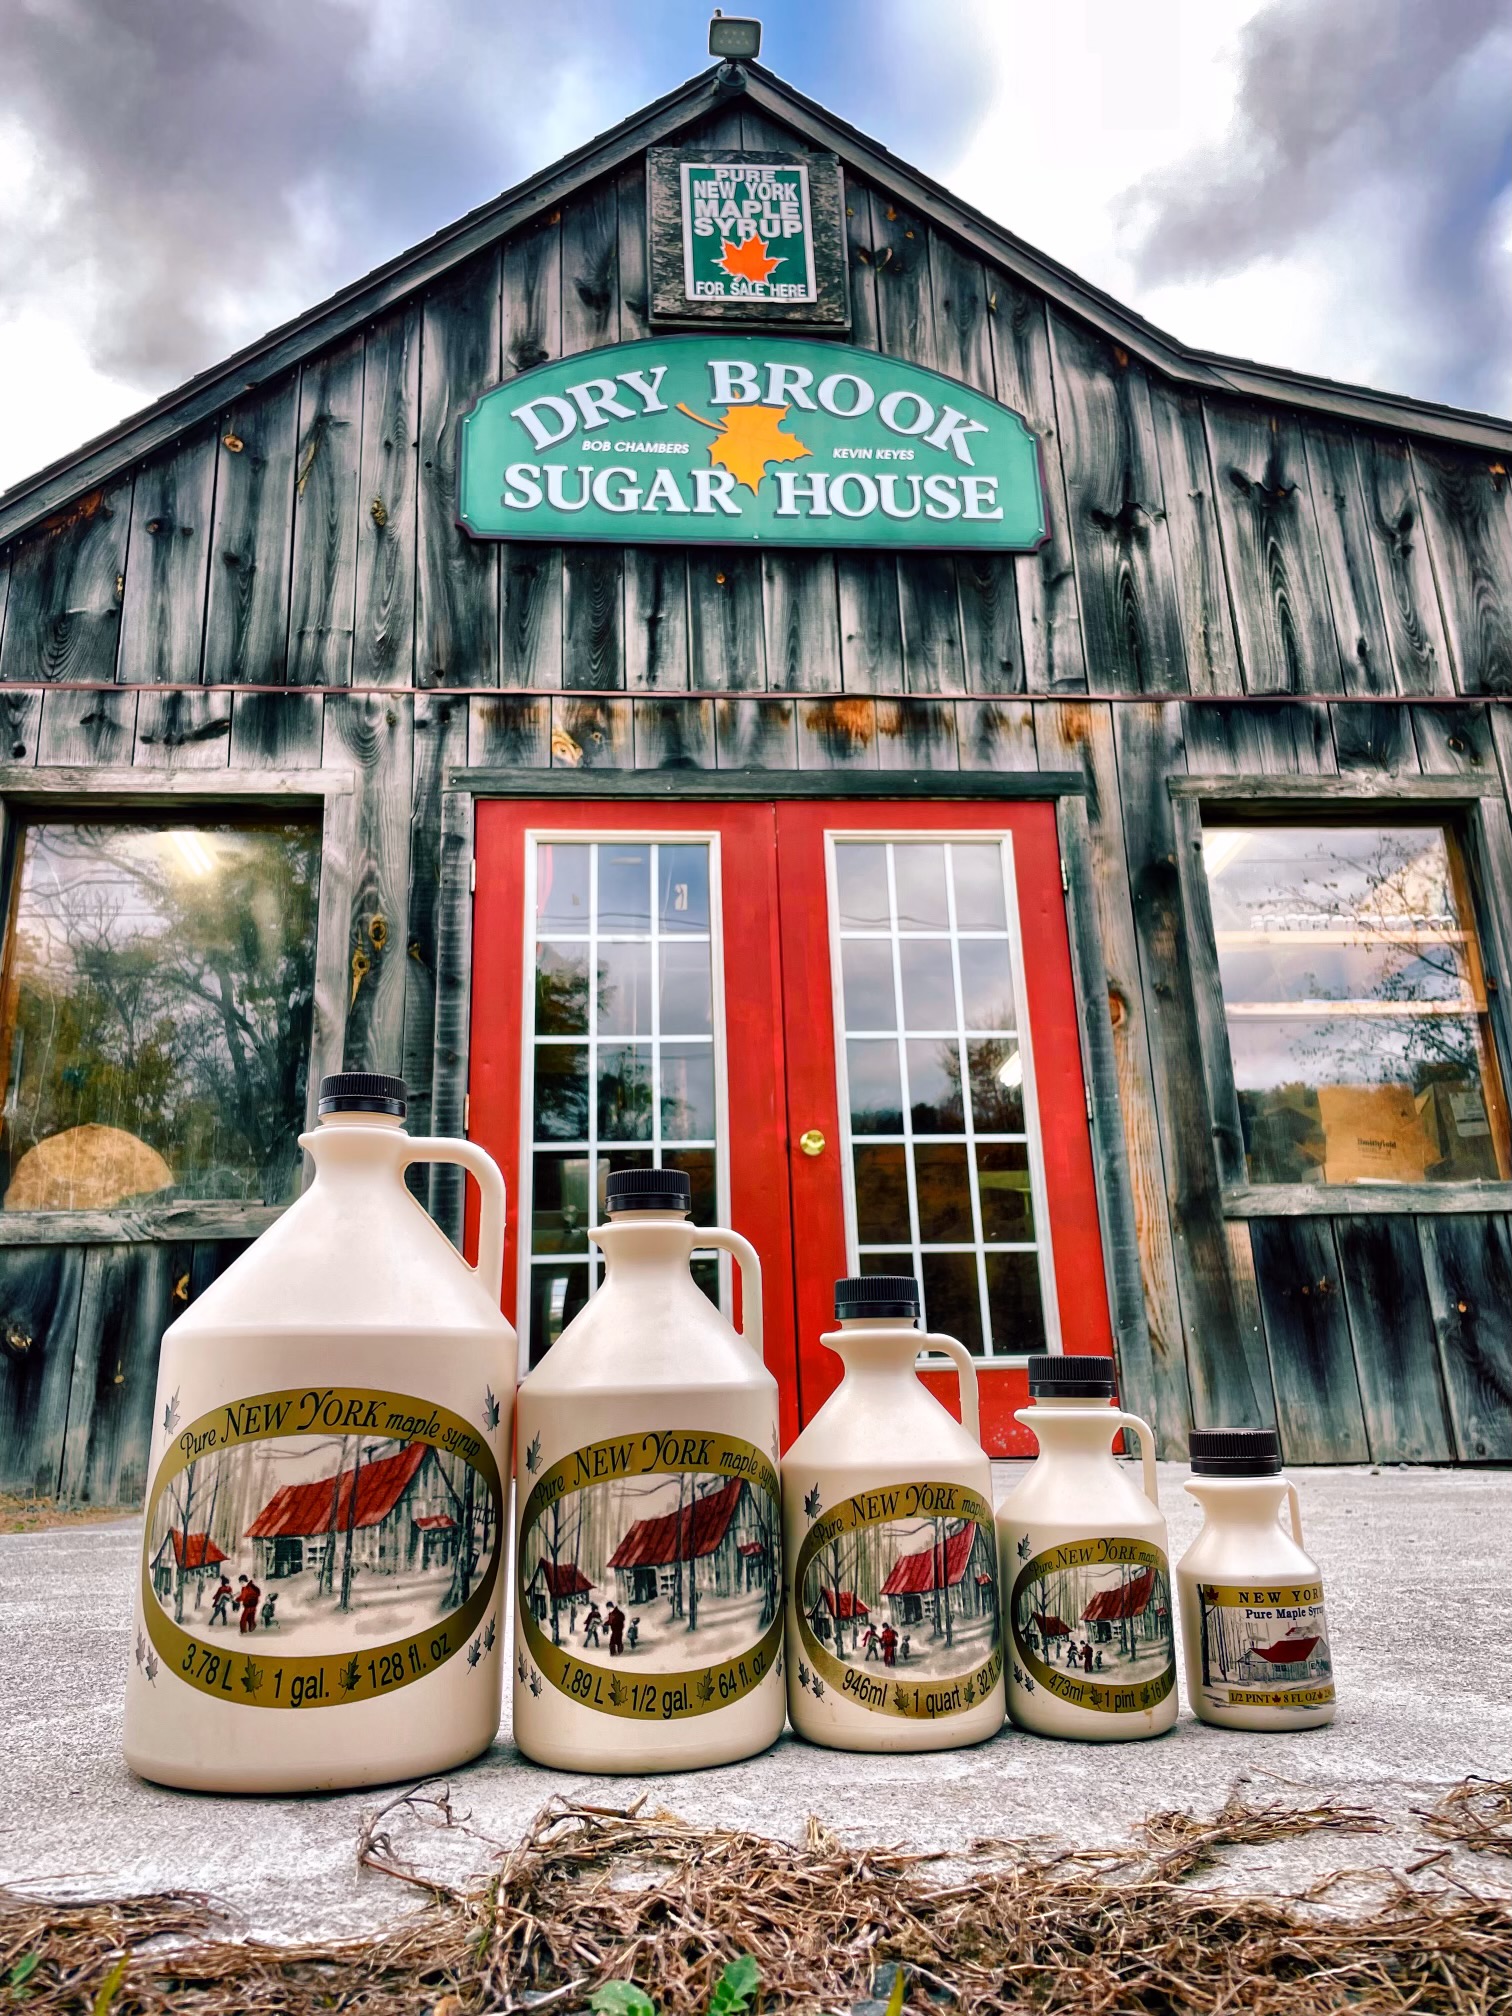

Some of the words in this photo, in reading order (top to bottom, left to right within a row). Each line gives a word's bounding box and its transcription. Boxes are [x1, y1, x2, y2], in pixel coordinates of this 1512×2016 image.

[693, 180, 736, 199] NEW
[745, 181, 799, 201] YORK
[714, 169, 776, 183] PURE
[694, 199, 800, 220] MAPLE
[694, 218, 803, 238] SYRUP
[696, 281, 724, 296] FOR
[730, 282, 765, 297] SALE
[769, 283, 806, 298] HERE
[511, 365, 670, 452] DRY
[707, 361, 989, 467] BROOK
[582, 440, 612, 452] BOB
[614, 441, 690, 454] CHAMBERS
[833, 448, 872, 460] KEVIN
[875, 448, 915, 461] KEYES
[503, 463, 742, 515] SUGAR
[775, 473, 1004, 520] HOUSE
[180, 1428, 216, 1459] Pure
[220, 1402, 292, 1443] NEW
[297, 1390, 386, 1431] YORK
[385, 1411, 441, 1440] maple
[442, 1427, 481, 1457] syrup
[534, 1476, 565, 1506] Pure
[573, 1442, 634, 1485] NEW
[642, 1431, 715, 1472] YORK
[720, 1448, 758, 1478] maple
[812, 1518, 844, 1545] Pure
[850, 1492, 901, 1528] NEW
[905, 1483, 959, 1517] YORK
[1029, 1560, 1053, 1577] Pure
[1056, 1546, 1094, 1569] NEW
[1097, 1537, 1138, 1562] YORK
[1238, 1591, 1281, 1604] NEW
[1245, 1609, 1272, 1619] Pure
[1275, 1607, 1306, 1621] Maple
[182, 1643, 222, 1686] 3.78
[222, 1658, 232, 1692] L
[274, 1669, 281, 1699] 1
[290, 1670, 330, 1708] gal.
[367, 1651, 405, 1689] 128
[407, 1643, 427, 1673] fl.
[430, 1632, 451, 1660] oz
[560, 1662, 592, 1698] 1.89
[594, 1678, 604, 1705] L
[631, 1685, 657, 1713] 1/2
[662, 1683, 693, 1720] gal.
[718, 1673, 737, 1699] 64
[738, 1662, 752, 1688] fl.
[753, 1651, 767, 1676] oz
[842, 1669, 889, 1707] 946ml
[913, 1688, 919, 1713] 1
[925, 1685, 962, 1719] quart
[977, 1669, 990, 1696] 32
[1048, 1673, 1085, 1702] 473ml
[1105, 1690, 1110, 1708] 1
[1114, 1690, 1136, 1712] pint
[1151, 1681, 1162, 1701] 16
[1230, 1692, 1244, 1702] 1/2
[1245, 1693, 1271, 1704] PINT
[1283, 1693, 1289, 1703] 8
[1291, 1693, 1303, 1703] FL
[1305, 1691, 1317, 1702] OZ
